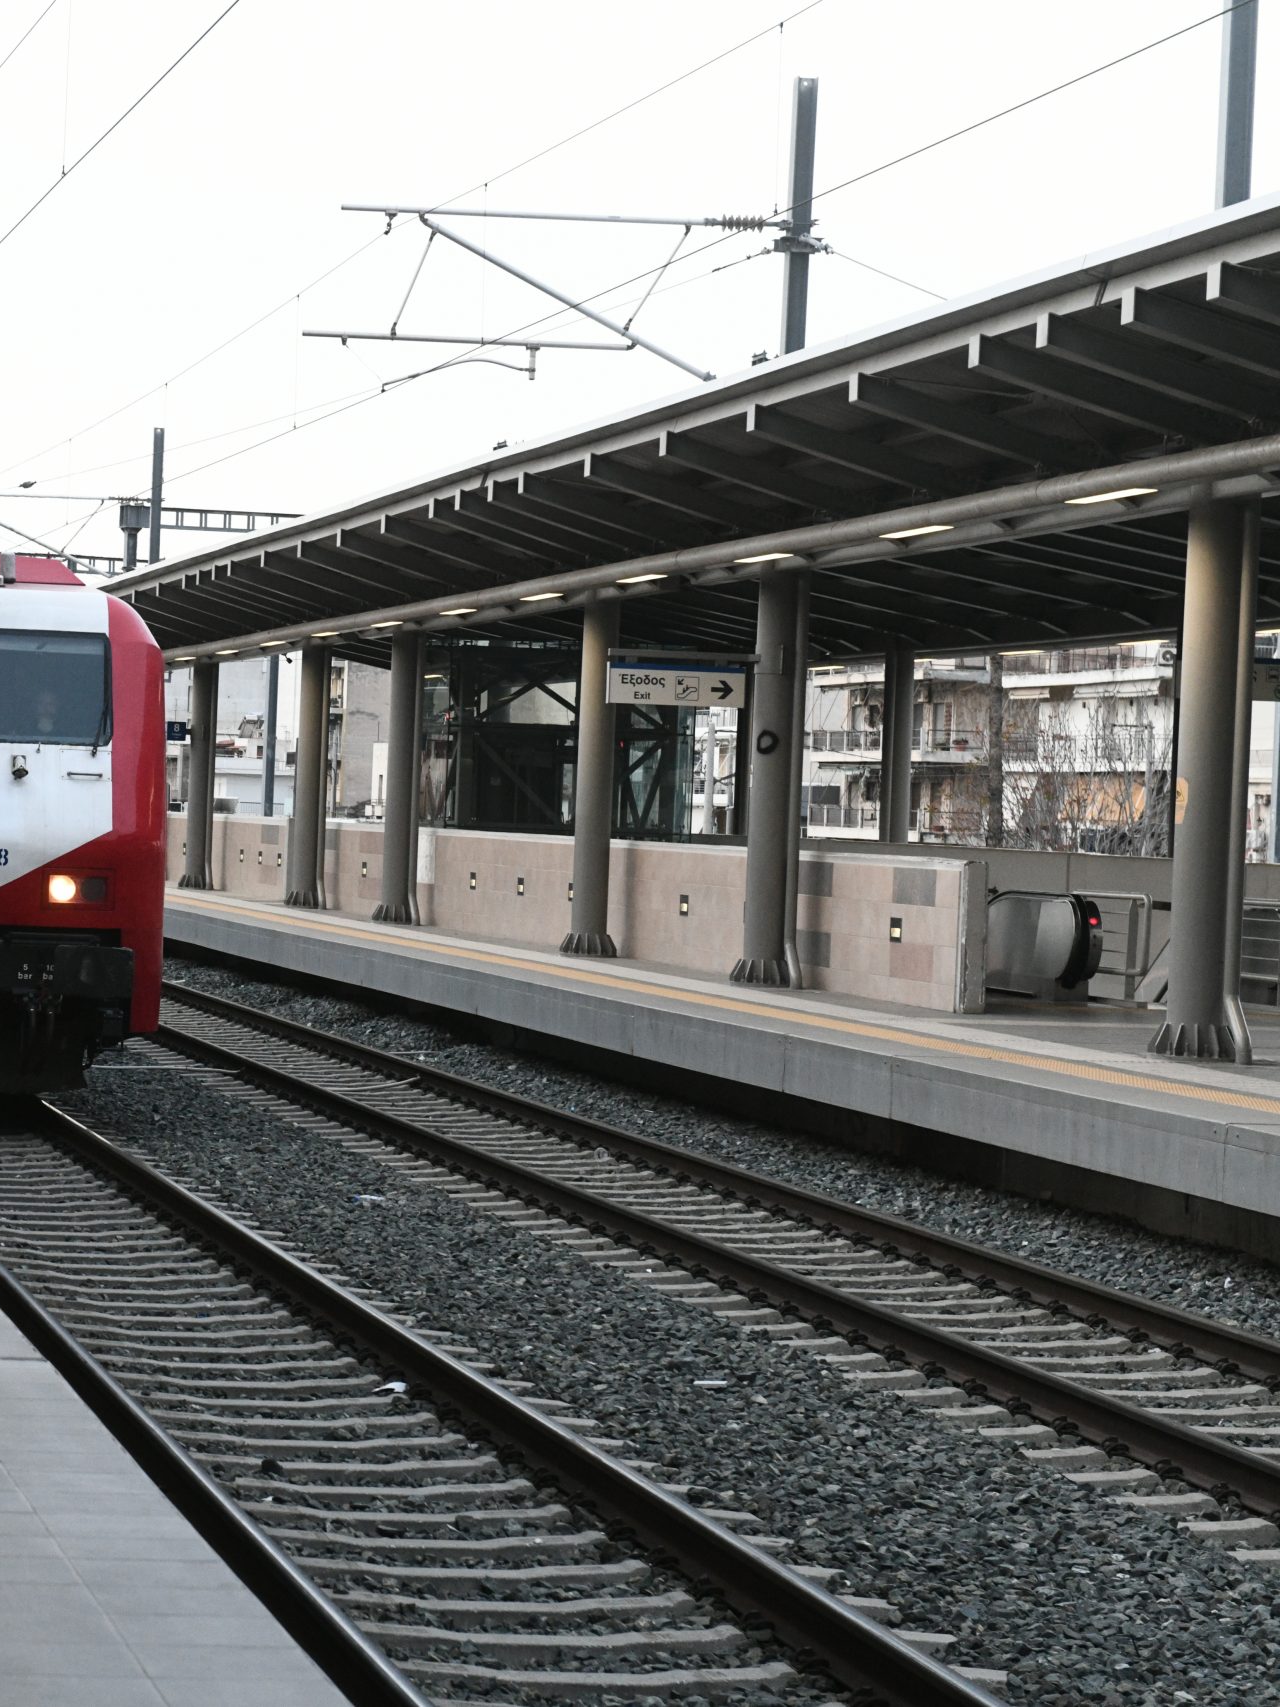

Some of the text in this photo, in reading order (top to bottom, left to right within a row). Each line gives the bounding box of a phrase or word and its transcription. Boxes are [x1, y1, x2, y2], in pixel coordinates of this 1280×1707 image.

[619, 673, 666, 688] Έξοδος
[634, 691, 651, 700] Exit
[23, 963, 29, 971] 5
[17, 971, 32, 980] bar
